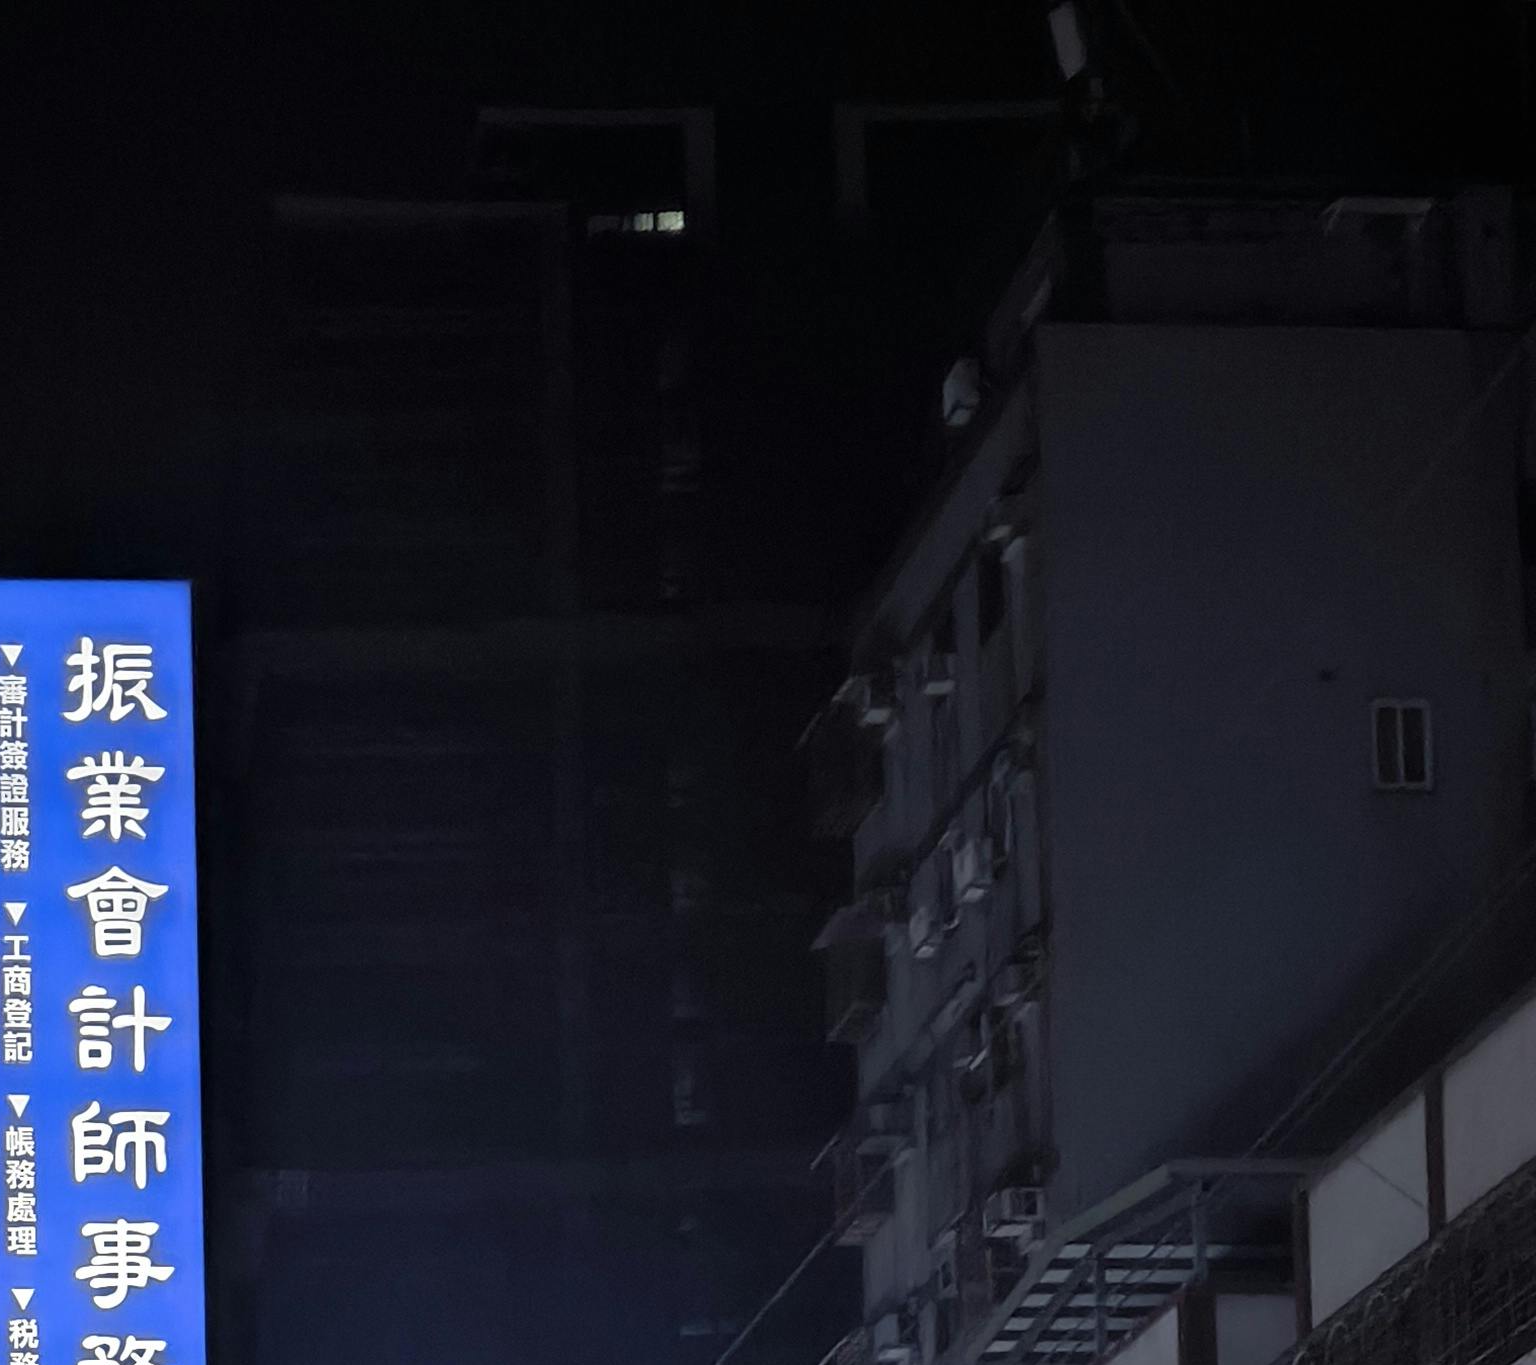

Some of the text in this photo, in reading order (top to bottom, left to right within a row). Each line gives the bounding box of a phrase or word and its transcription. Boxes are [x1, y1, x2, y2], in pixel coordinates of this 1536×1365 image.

[2, 935, 33, 1063] 工商登記
[5, 1125, 38, 1255] 帳務處理
